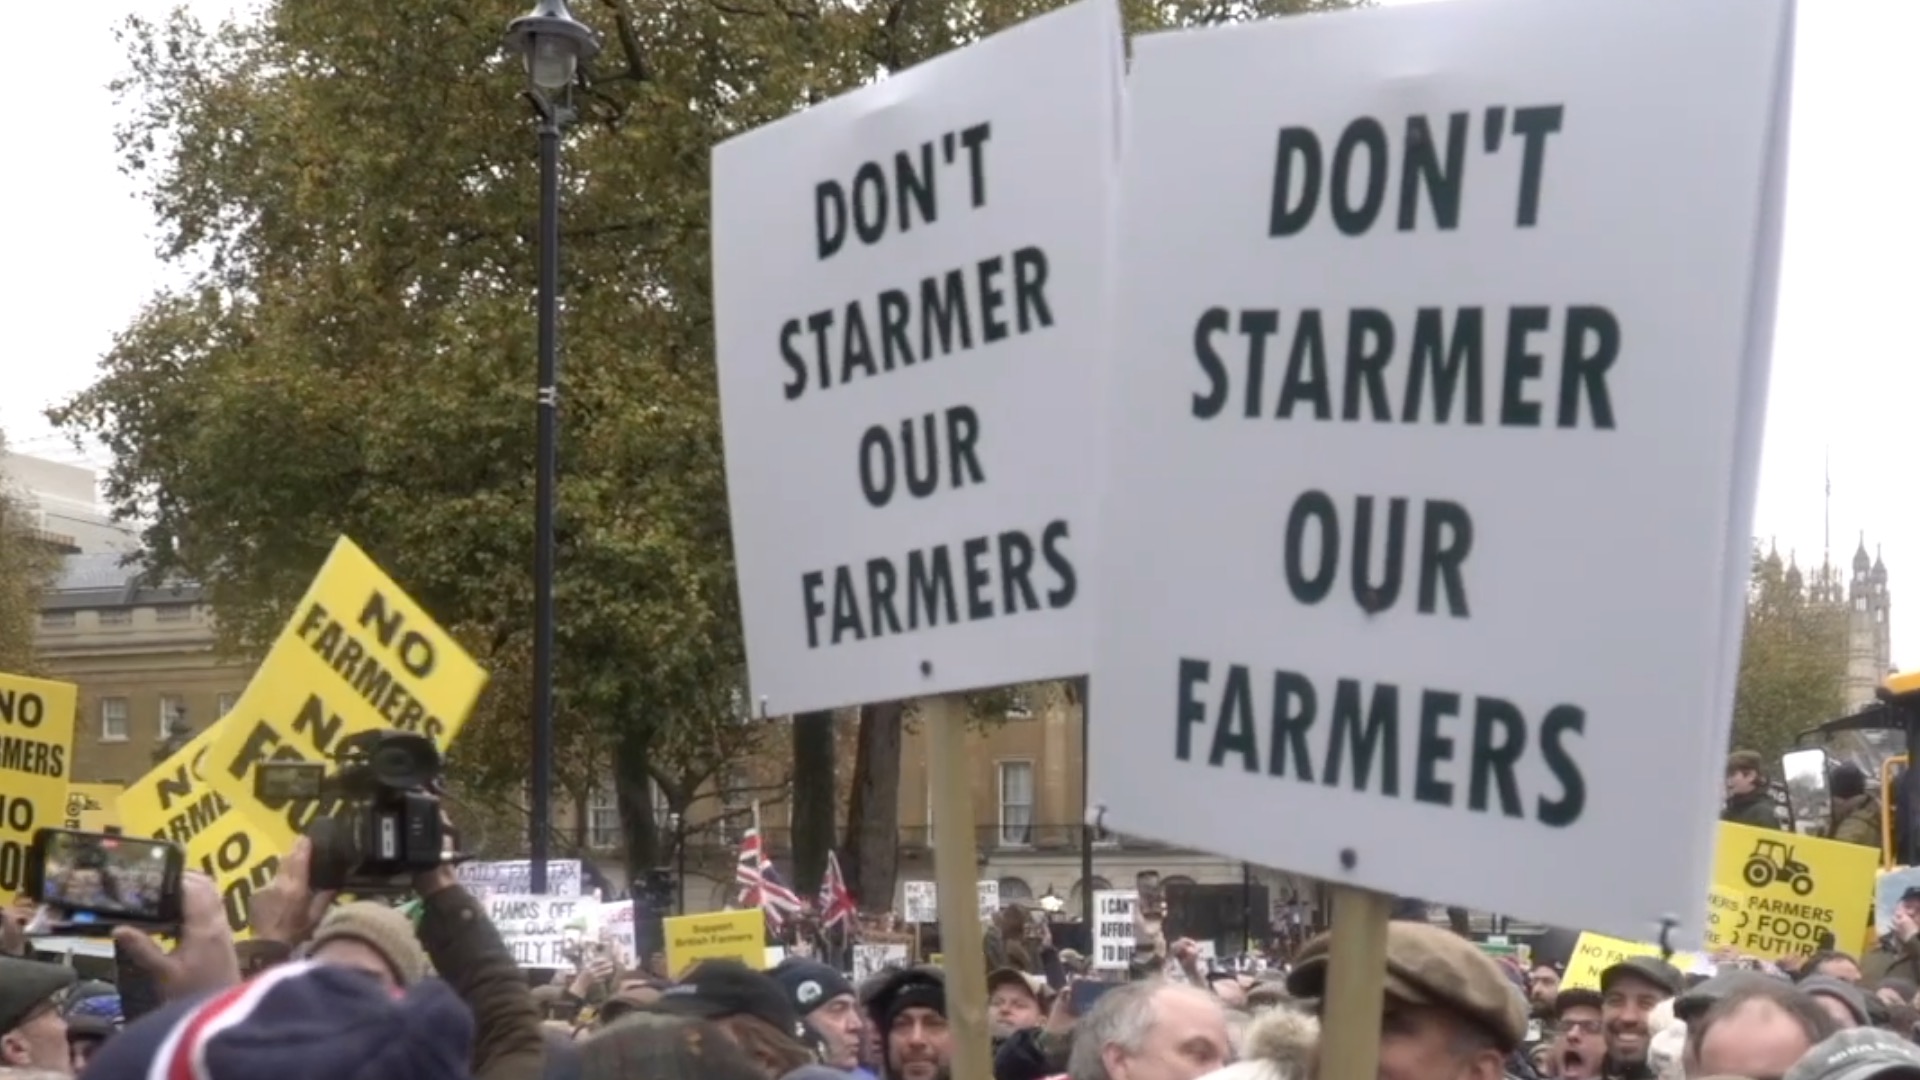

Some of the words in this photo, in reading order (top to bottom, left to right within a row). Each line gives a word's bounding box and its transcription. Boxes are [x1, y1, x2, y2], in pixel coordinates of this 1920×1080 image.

[816, 123, 990, 260] DON'T
[1269, 106, 1563, 237] DON'T
[780, 247, 1053, 400] STARMER
[1192, 306, 1620, 429] STARMER
[859, 406, 984, 507] OUR
[802, 520, 1077, 648] FARMERS
[1284, 490, 1473, 617] OUR
[358, 589, 434, 679] NO
[0, 736, 63, 777] MERS
[1176, 658, 1586, 828] FARMERS
[0, 795, 33, 832] O
[491, 901, 540, 919] HANDS
[549, 902, 577, 919] OFF
[1103, 945, 1115, 961] TO
[1581, 944, 1602, 958] NO
[1606, 950, 1632, 962] FA
[1746, 932, 1815, 957] FUTUR
[1588, 965, 1600, 977] N
